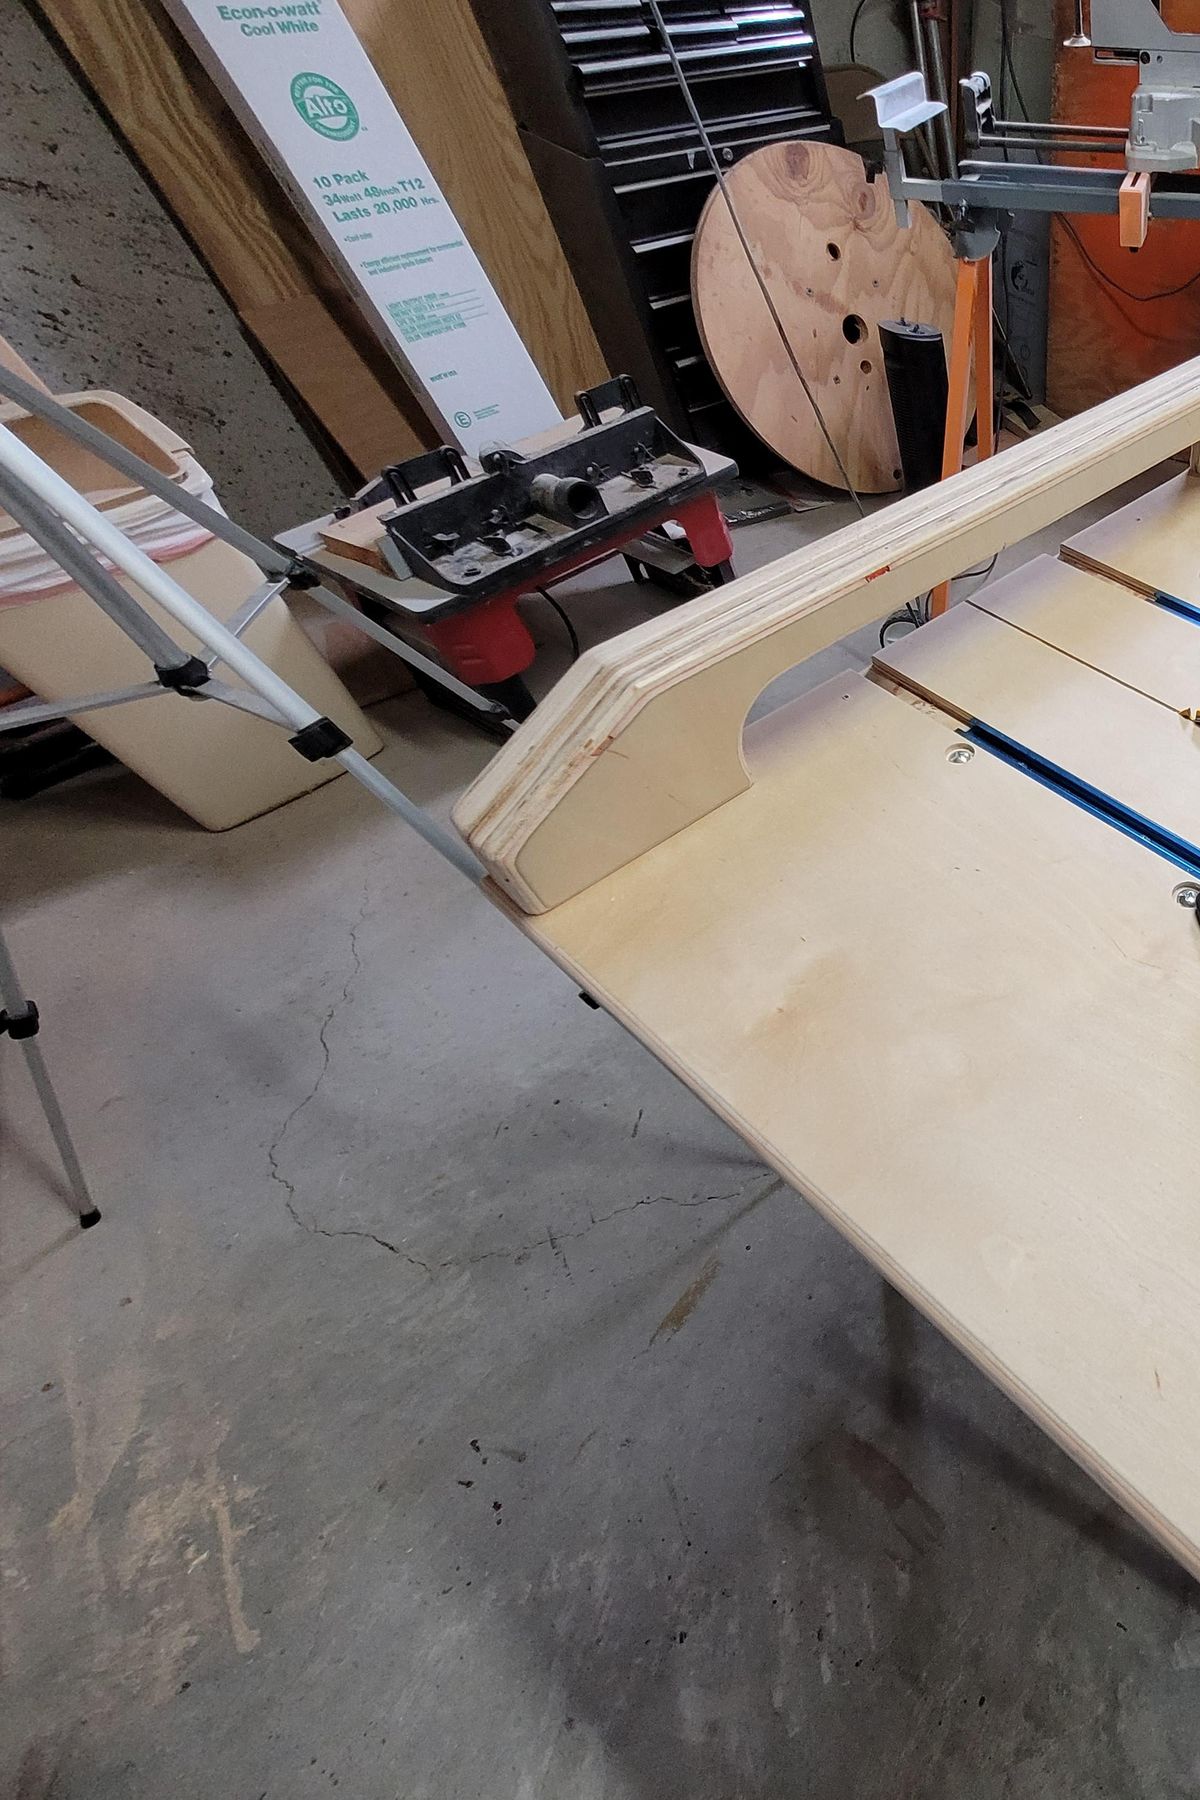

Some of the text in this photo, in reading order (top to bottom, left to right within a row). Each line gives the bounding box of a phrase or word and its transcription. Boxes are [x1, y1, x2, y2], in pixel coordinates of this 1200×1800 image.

[216, 2, 321, 21] Econ-o-watt
[240, 20, 319, 37] Cool White
[304, 95, 348, 118] Alto
[313, 170, 370, 189] 10 Pack
[398, 178, 425, 192] T12
[332, 207, 372, 223] Lasts
[374, 197, 418, 214] 20,000
